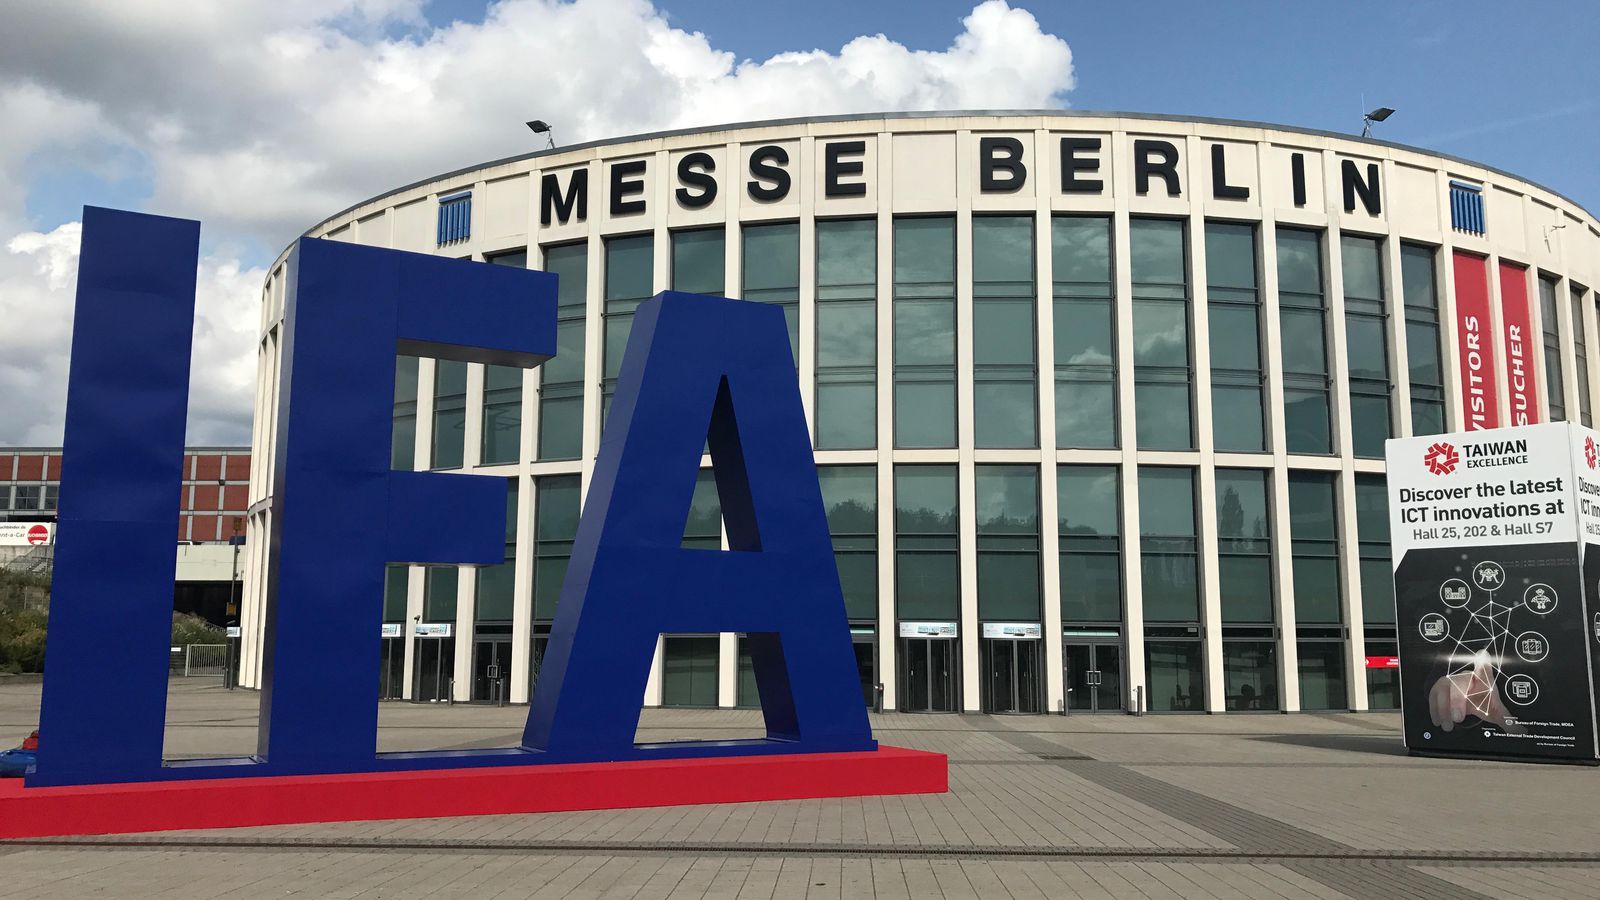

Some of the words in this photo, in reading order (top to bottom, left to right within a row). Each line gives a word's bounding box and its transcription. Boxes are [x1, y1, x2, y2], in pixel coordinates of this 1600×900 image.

[540, 140, 867, 226] MESSE
[980, 136, 1382, 216] BERLIN
[1462, 439, 1528, 458] TAIWAN
[1466, 455, 1529, 469] EXCELLENCE
[26, 205, 877, 787] IFA
[1400, 486, 1472, 503] Discover
[1475, 482, 1506, 498] the
[1510, 477, 1564, 495] latest
[1401, 506, 1429, 524] ICT
[1433, 501, 1541, 522] innovations
[1545, 499, 1565, 515] at
[1580, 497, 1590, 515] ICT
[1413, 527, 1439, 540] Hall
[1441, 526, 1461, 540] 25,
[1463, 525, 1487, 538] 202
[1490, 524, 1501, 536] &
[1505, 523, 1532, 536] Hall
[1536, 521, 1554, 534] S7
